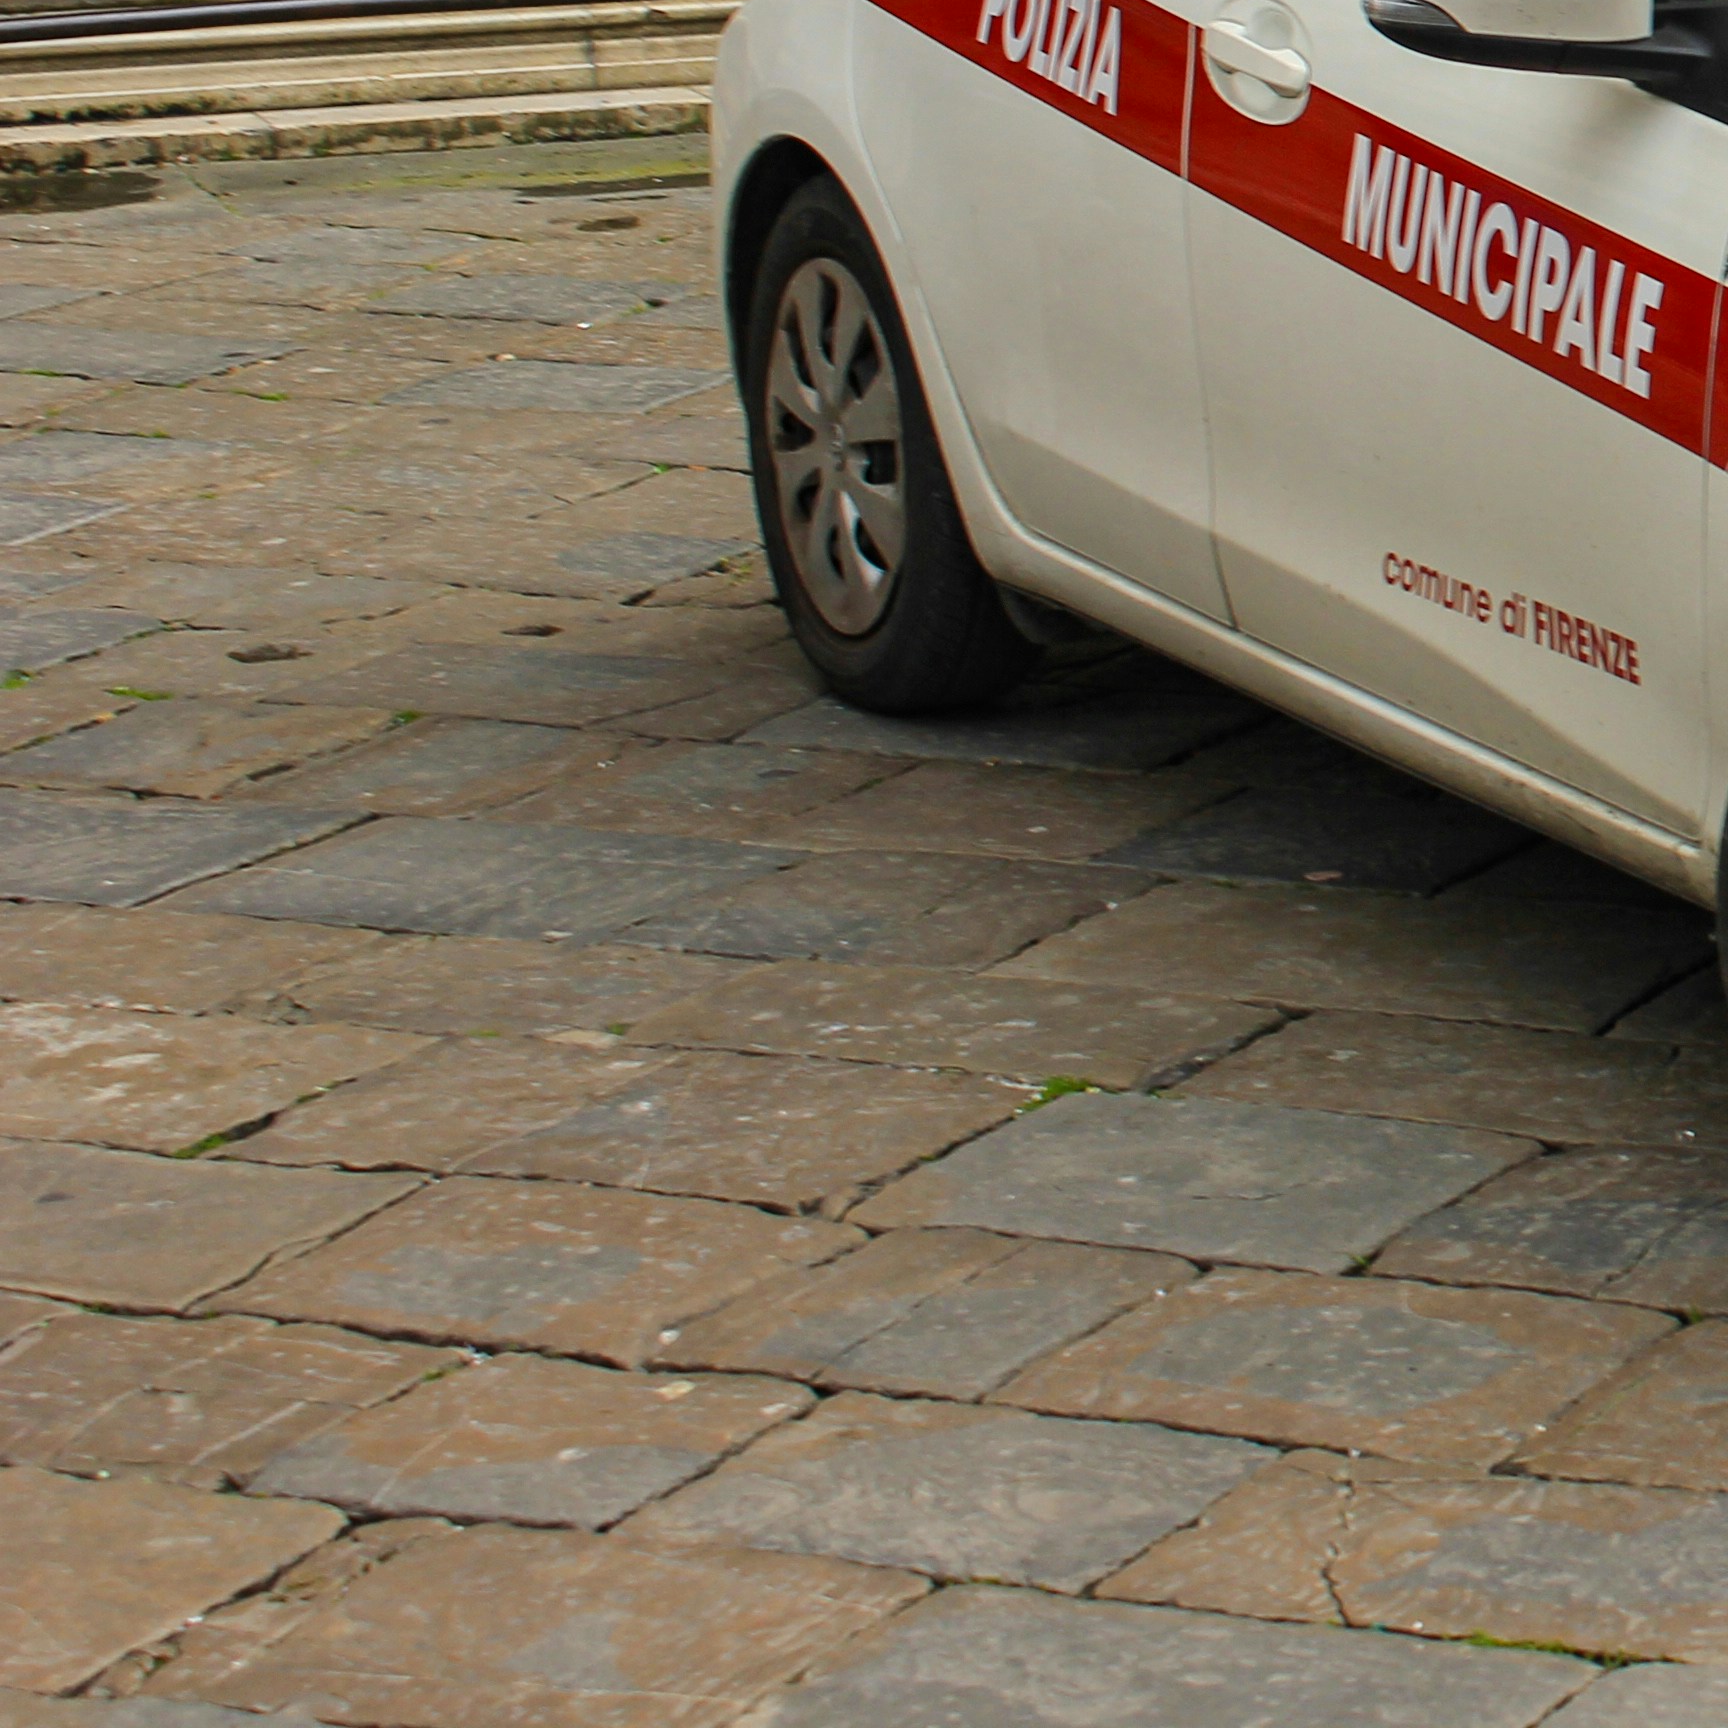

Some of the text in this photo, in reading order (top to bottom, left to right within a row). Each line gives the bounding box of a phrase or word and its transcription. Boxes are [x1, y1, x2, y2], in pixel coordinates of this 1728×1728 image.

[1342, 133, 1664, 399] MUNICIPALE
[1383, 551, 1642, 686] comune di FIRENZE
